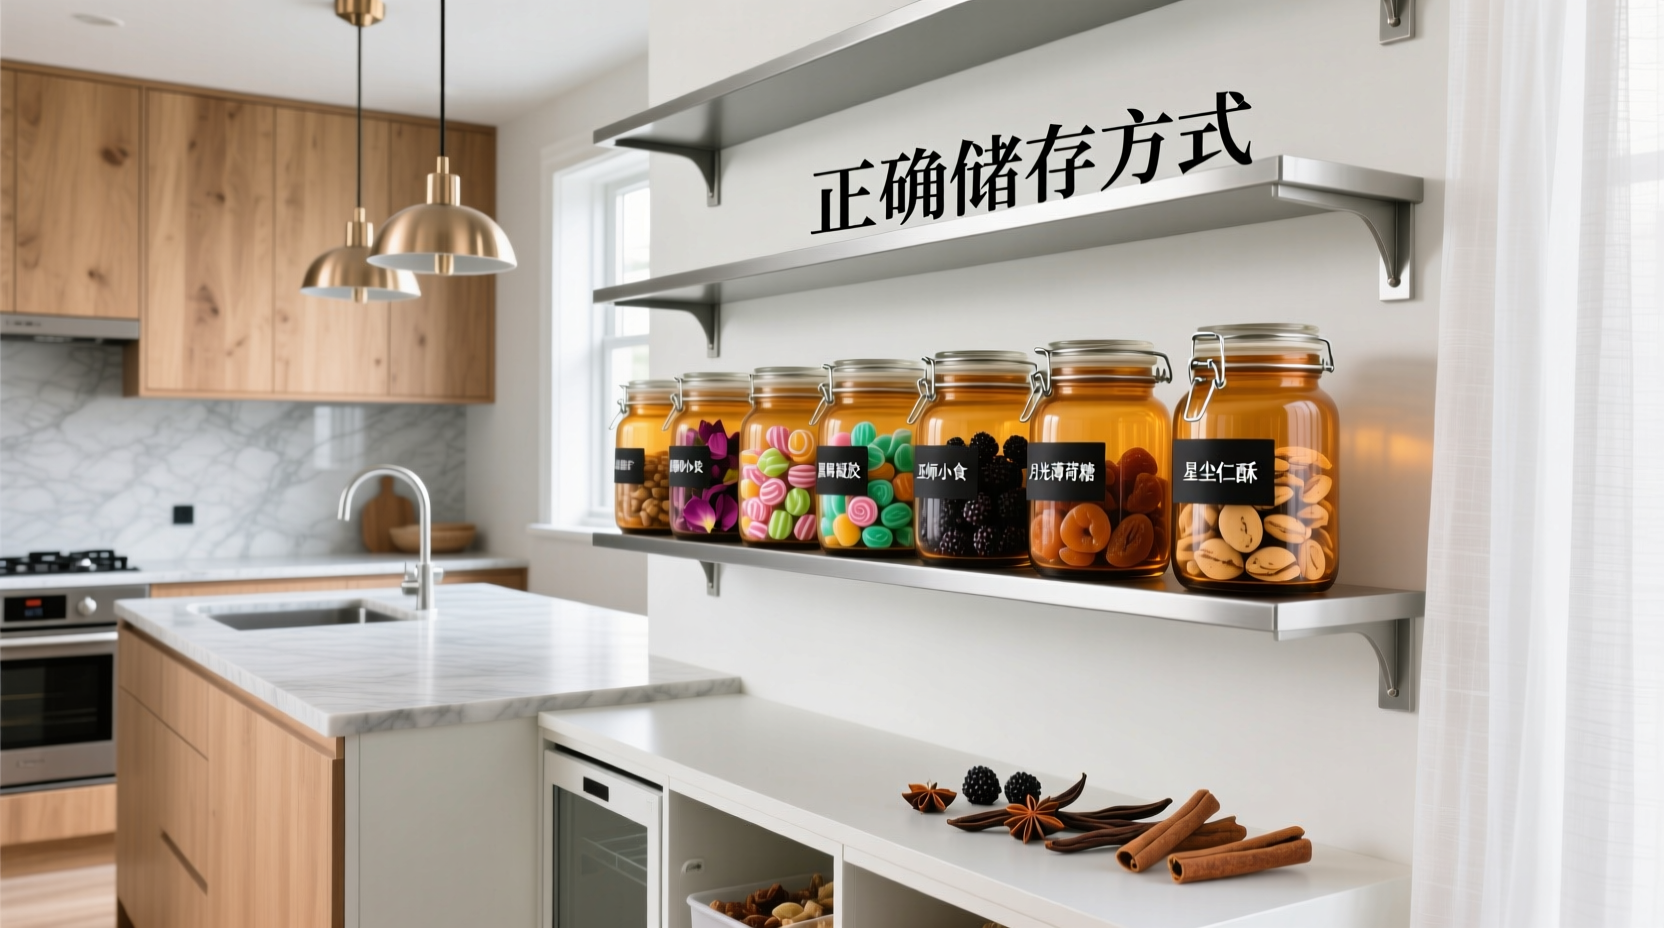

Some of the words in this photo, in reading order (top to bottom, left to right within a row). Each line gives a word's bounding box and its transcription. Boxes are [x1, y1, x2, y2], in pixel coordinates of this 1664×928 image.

[810, 90, 1253, 235] 正确储存方式
[1028, 461, 1095, 482] 月光薄荷糖
[1183, 460, 1258, 484] 星尘仁酥
